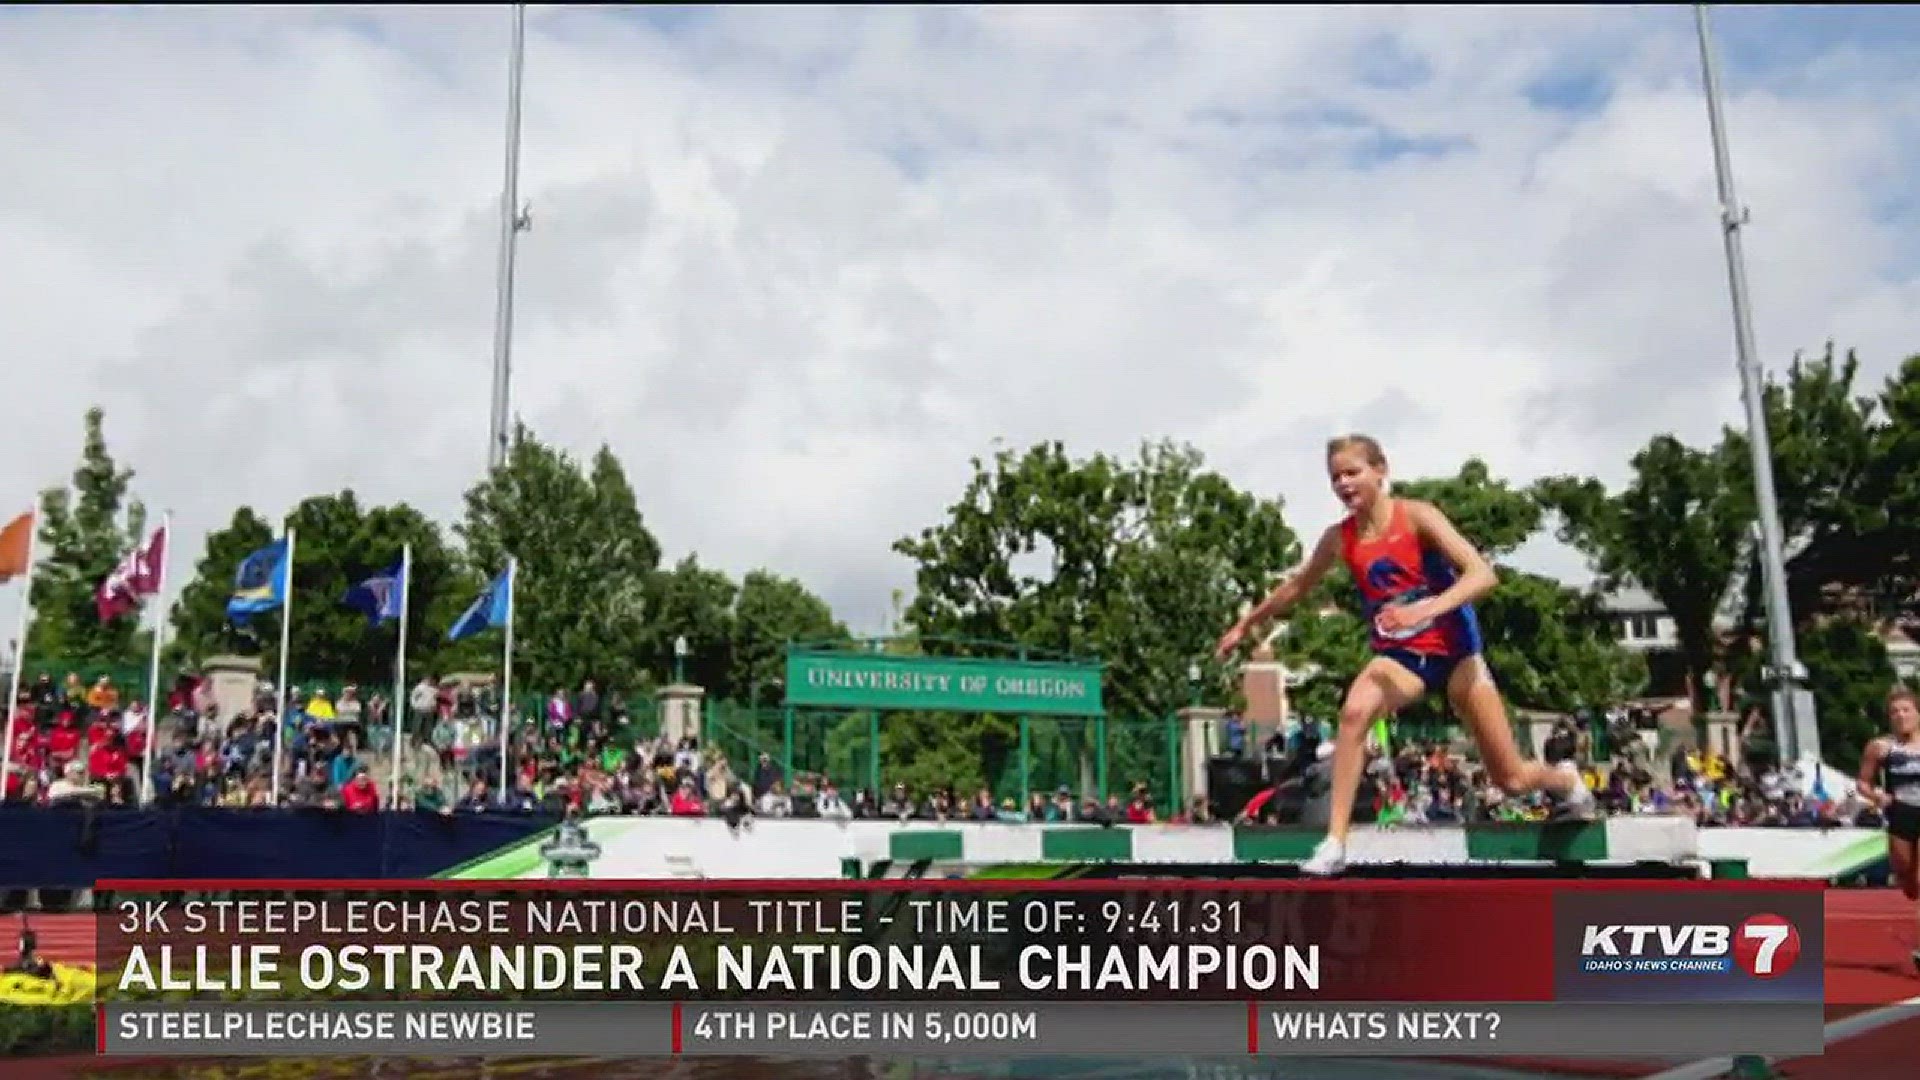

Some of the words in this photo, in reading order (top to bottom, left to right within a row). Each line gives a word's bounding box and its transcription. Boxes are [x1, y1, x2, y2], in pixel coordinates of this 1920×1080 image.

[807, 667, 951, 693] UNIVERSITY
[960, 676, 987, 695] OF
[996, 676, 1086, 698] OREGON
